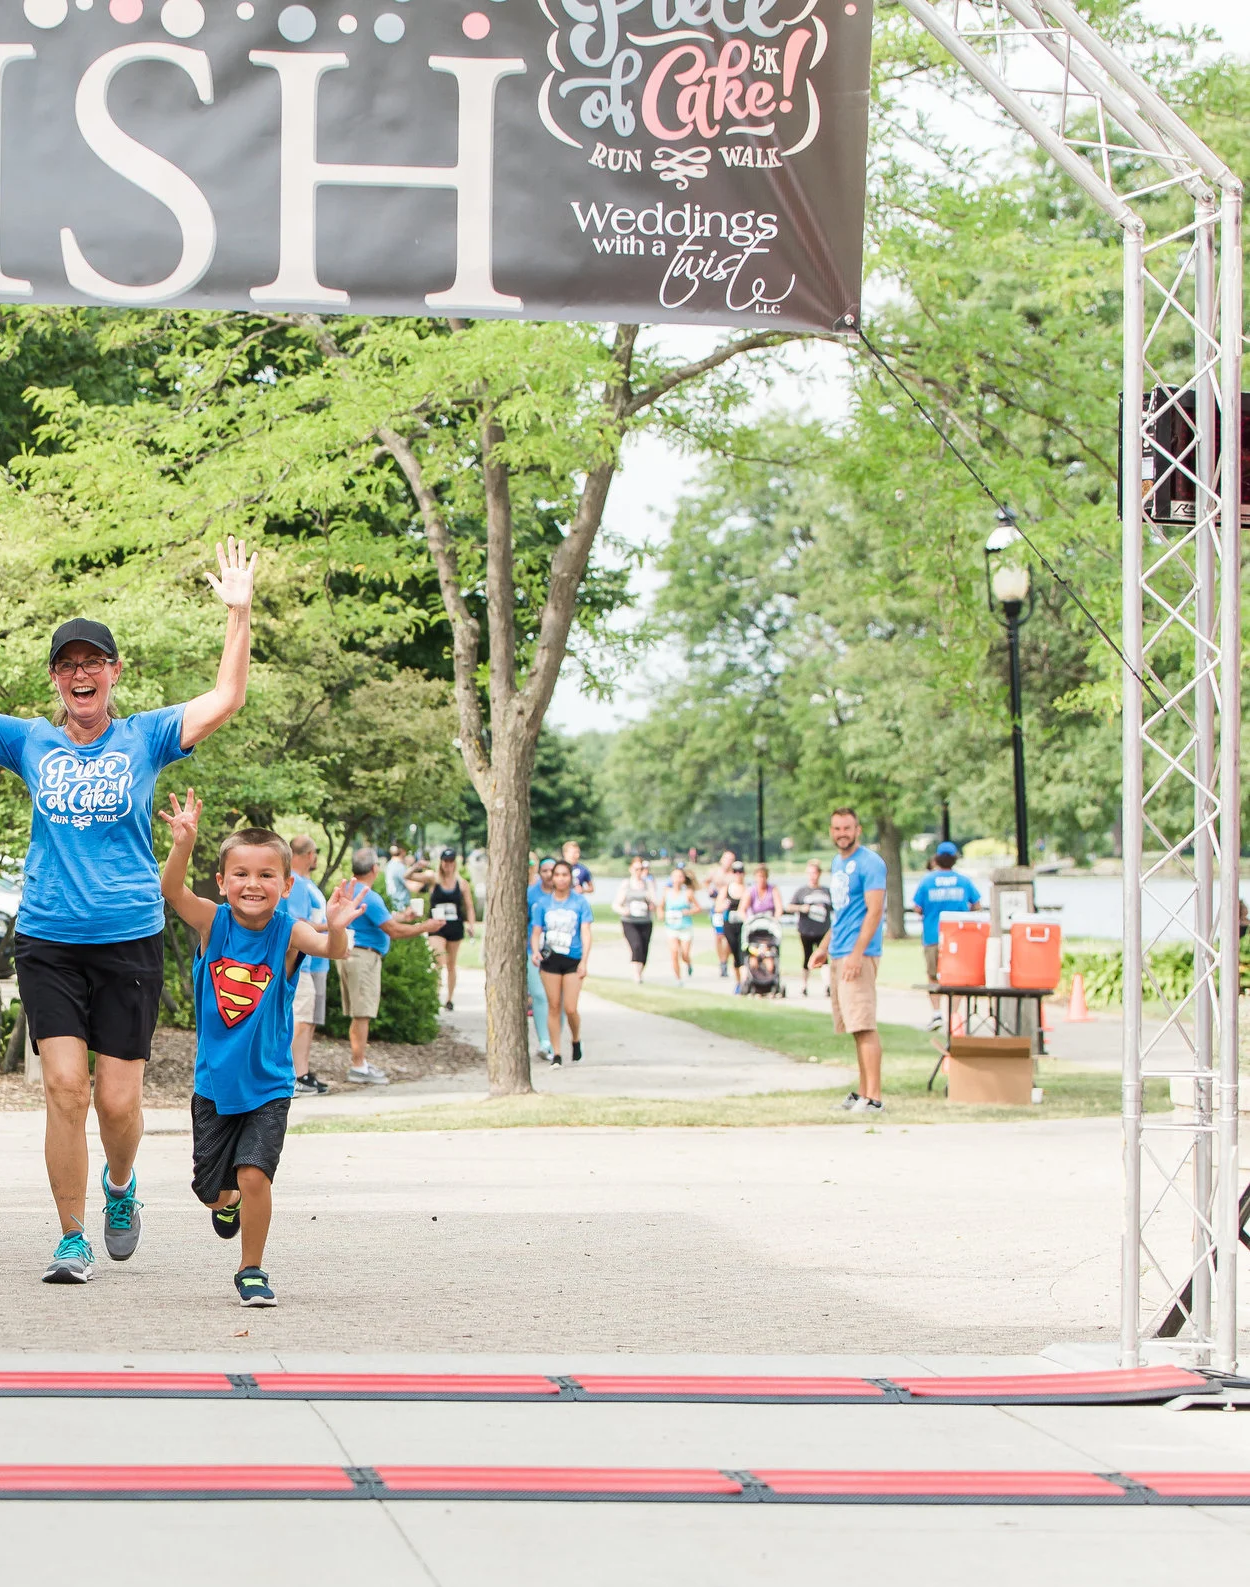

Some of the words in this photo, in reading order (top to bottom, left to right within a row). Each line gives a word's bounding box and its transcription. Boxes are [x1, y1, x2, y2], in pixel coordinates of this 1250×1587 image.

[753, 45, 781, 75] 5K
[559, 48, 643, 137] of
[642, 29, 812, 141] Cake!
[588, 142, 642, 173] RUN
[718, 145, 782, 168] WALK
[571, 201, 778, 246] Weddings
[592, 235, 645, 255] with
[651, 240, 666, 256] a
[659, 225, 795, 311] twist
[756, 304, 781, 314] LLC
[46, 755, 121, 788] Piece
[108, 782, 118, 791] 5K
[40, 781, 69, 812] of
[68, 776, 128, 813] Cake!
[50, 813, 69, 824] RUN
[95, 814, 118, 823] WALK
